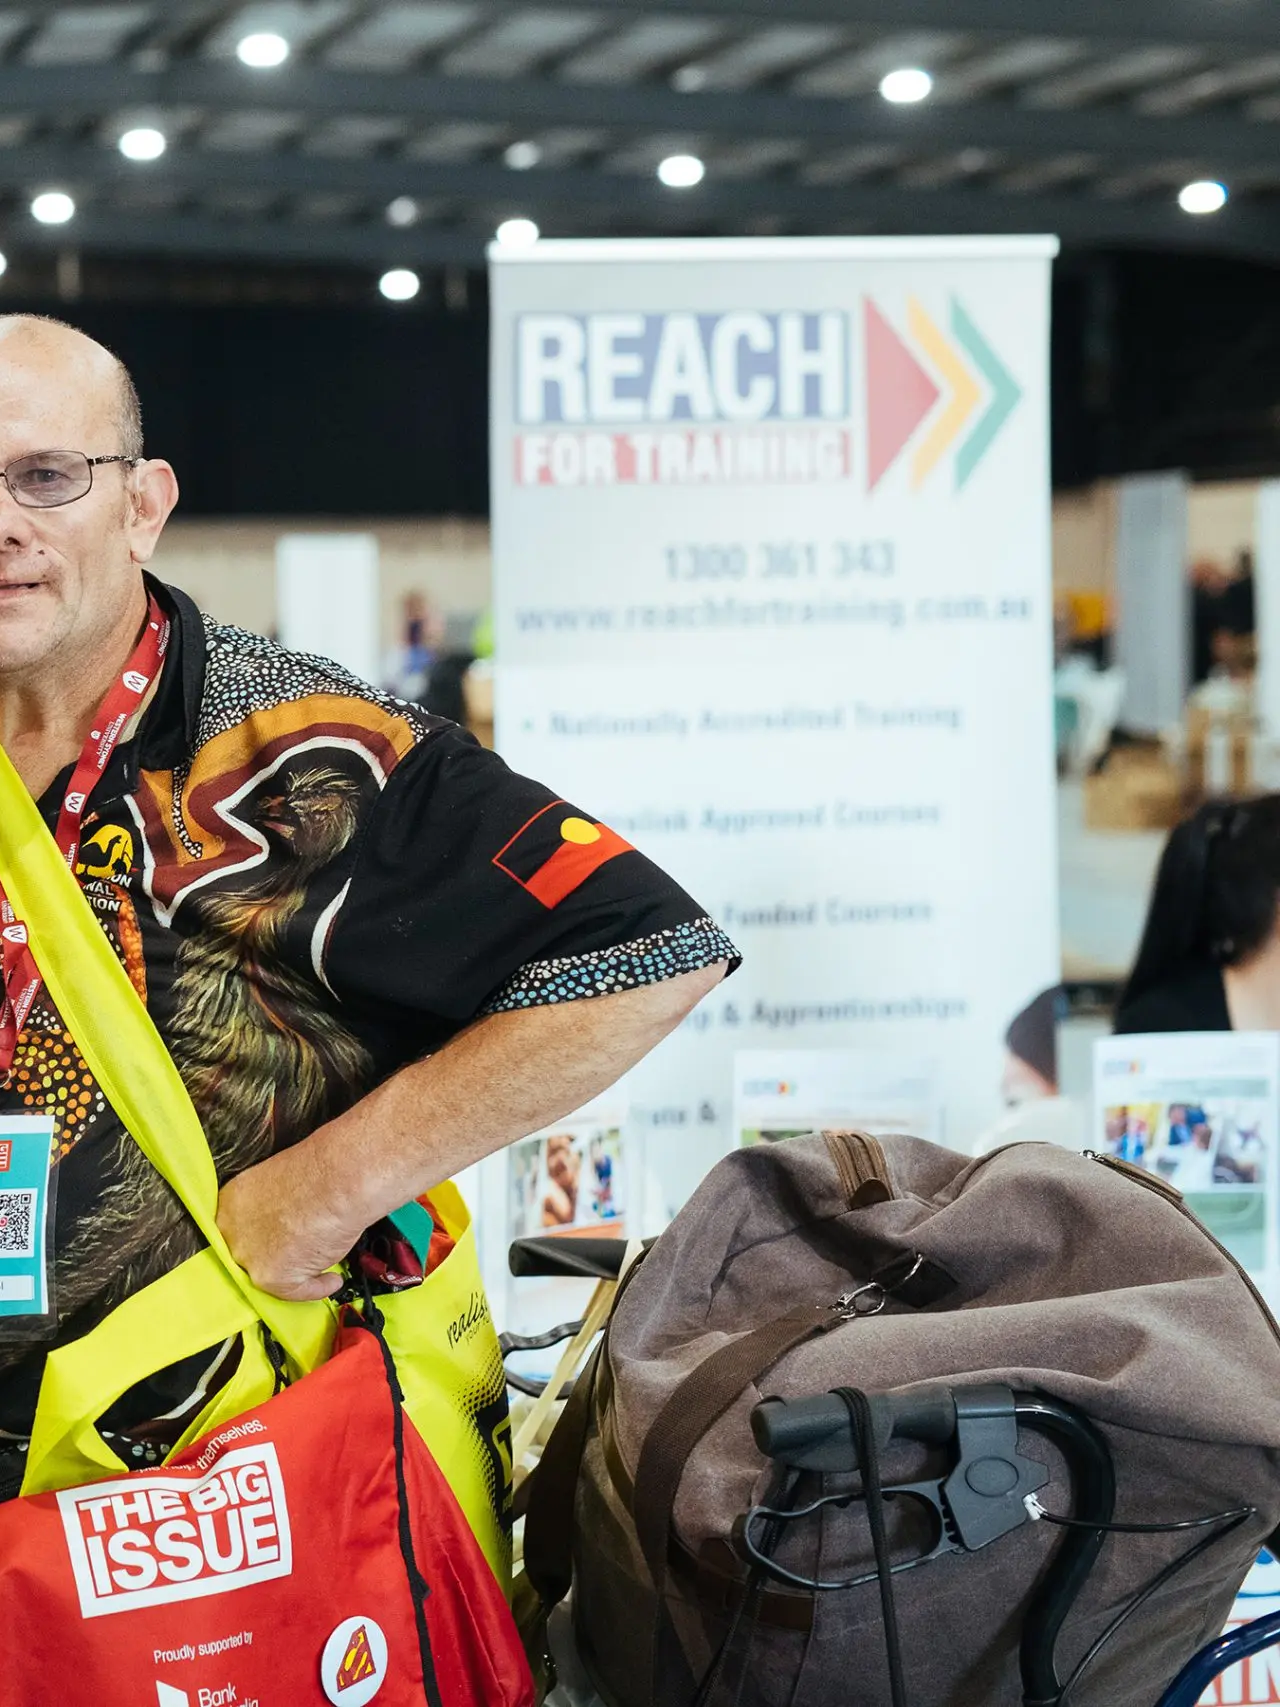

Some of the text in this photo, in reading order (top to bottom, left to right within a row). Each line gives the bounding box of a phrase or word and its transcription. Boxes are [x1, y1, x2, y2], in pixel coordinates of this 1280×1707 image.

[521, 311, 844, 422] REACH
[521, 429, 846, 486] FOR TRAINING
[664, 540, 897, 582] 1300 361 343
[516, 594, 1034, 634] www.reachfortraining.com.au
[549, 700, 964, 742] Nationally Accredited Training
[700, 805, 825, 836] Approved
[832, 801, 942, 828] Courses
[827, 898, 934, 925] Courses
[196, 1419, 268, 1470] themselves.
[78, 1465, 270, 1534] THE BIG
[86, 1502, 280, 1597] ISSUE
[153, 1630, 253, 1664] Proudly supported by
[197, 1682, 238, 1707] Bank
